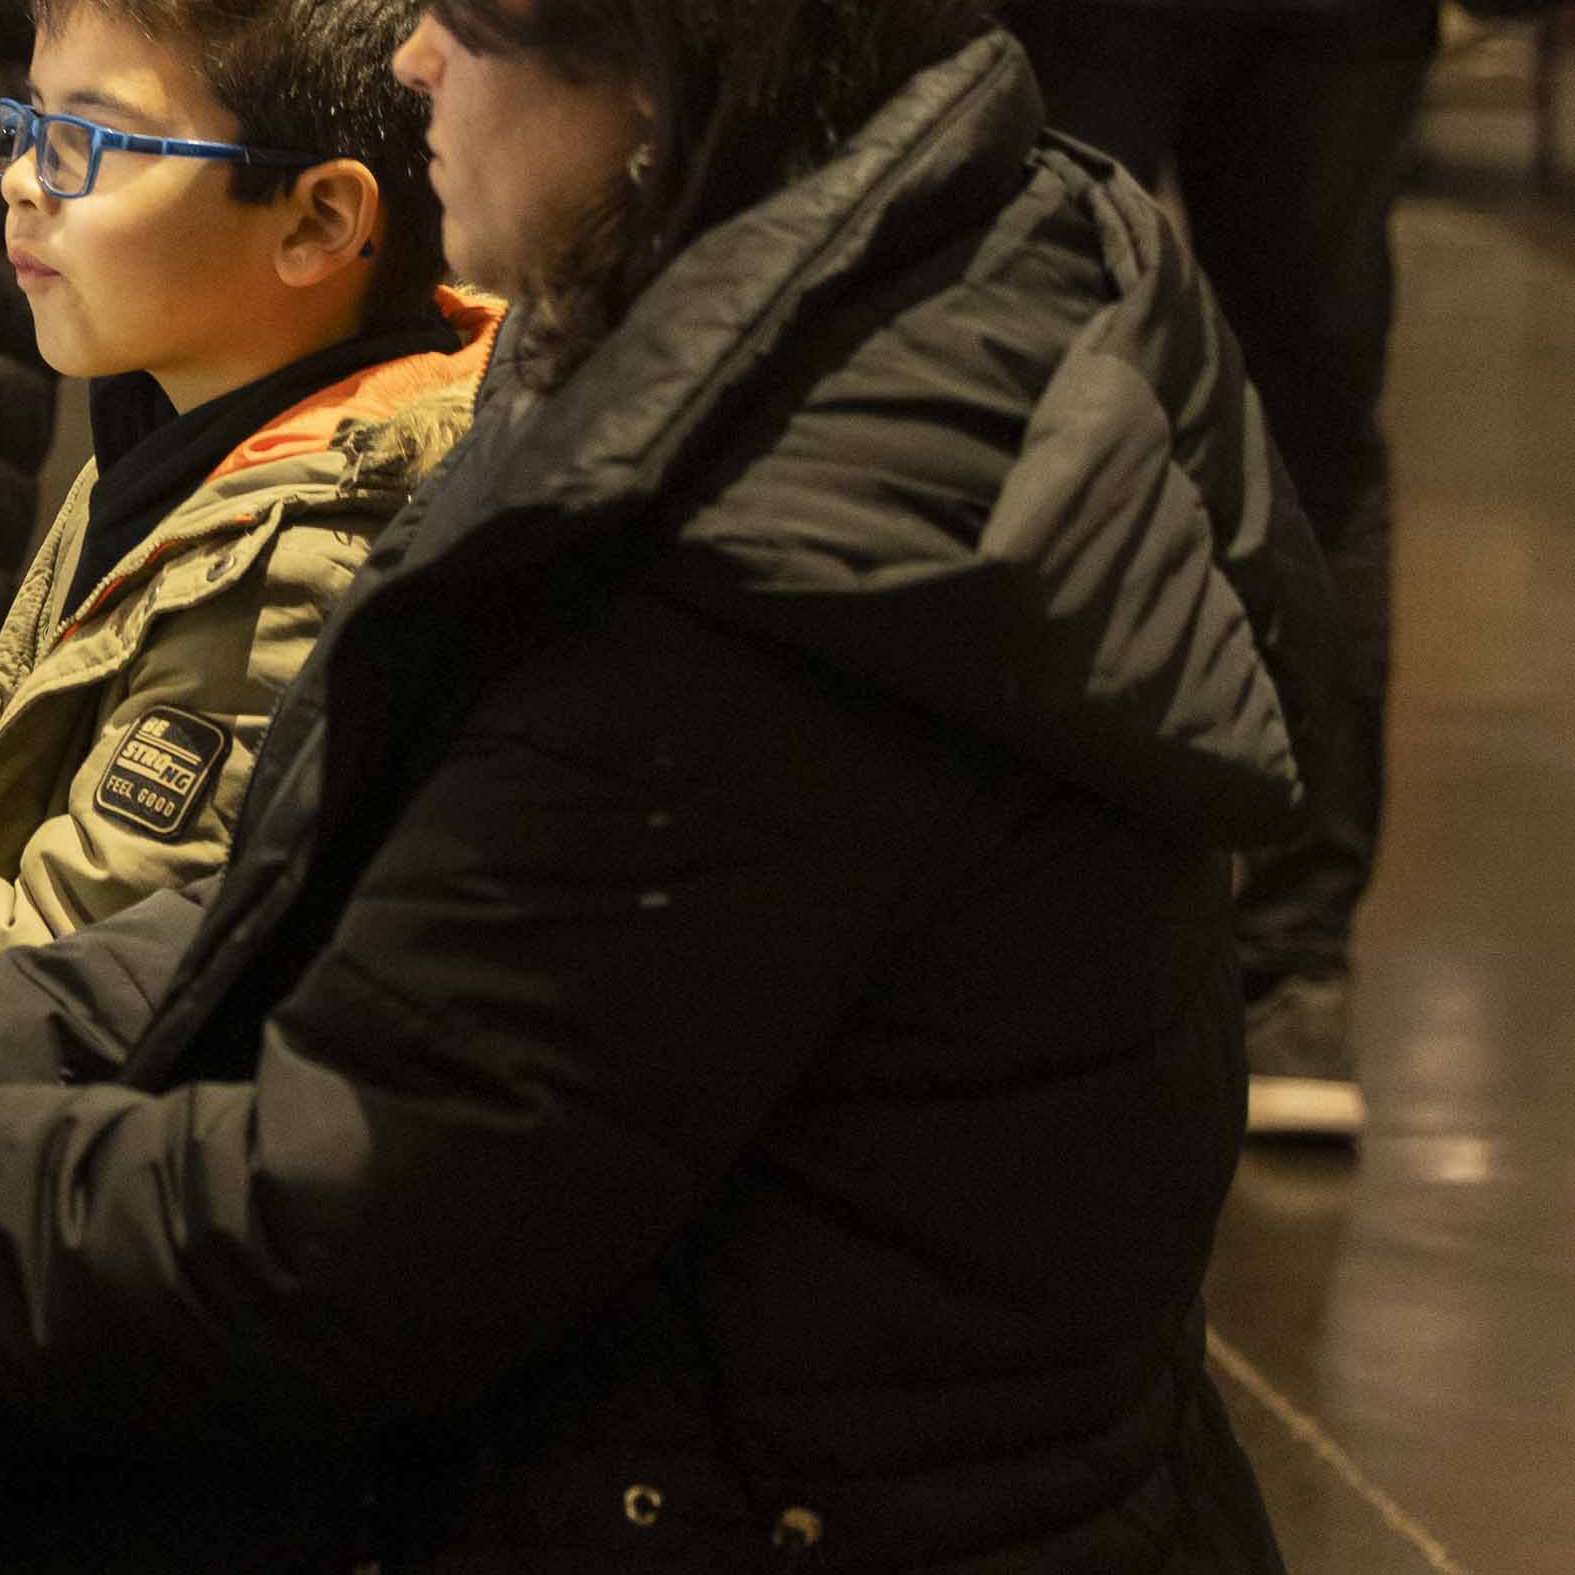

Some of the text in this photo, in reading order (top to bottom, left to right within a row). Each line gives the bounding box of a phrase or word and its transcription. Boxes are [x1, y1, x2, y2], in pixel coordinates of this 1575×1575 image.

[142, 717, 170, 737] BE
[122, 741, 190, 791] STRONG
[107, 776, 176, 817] FEEL GOOD
